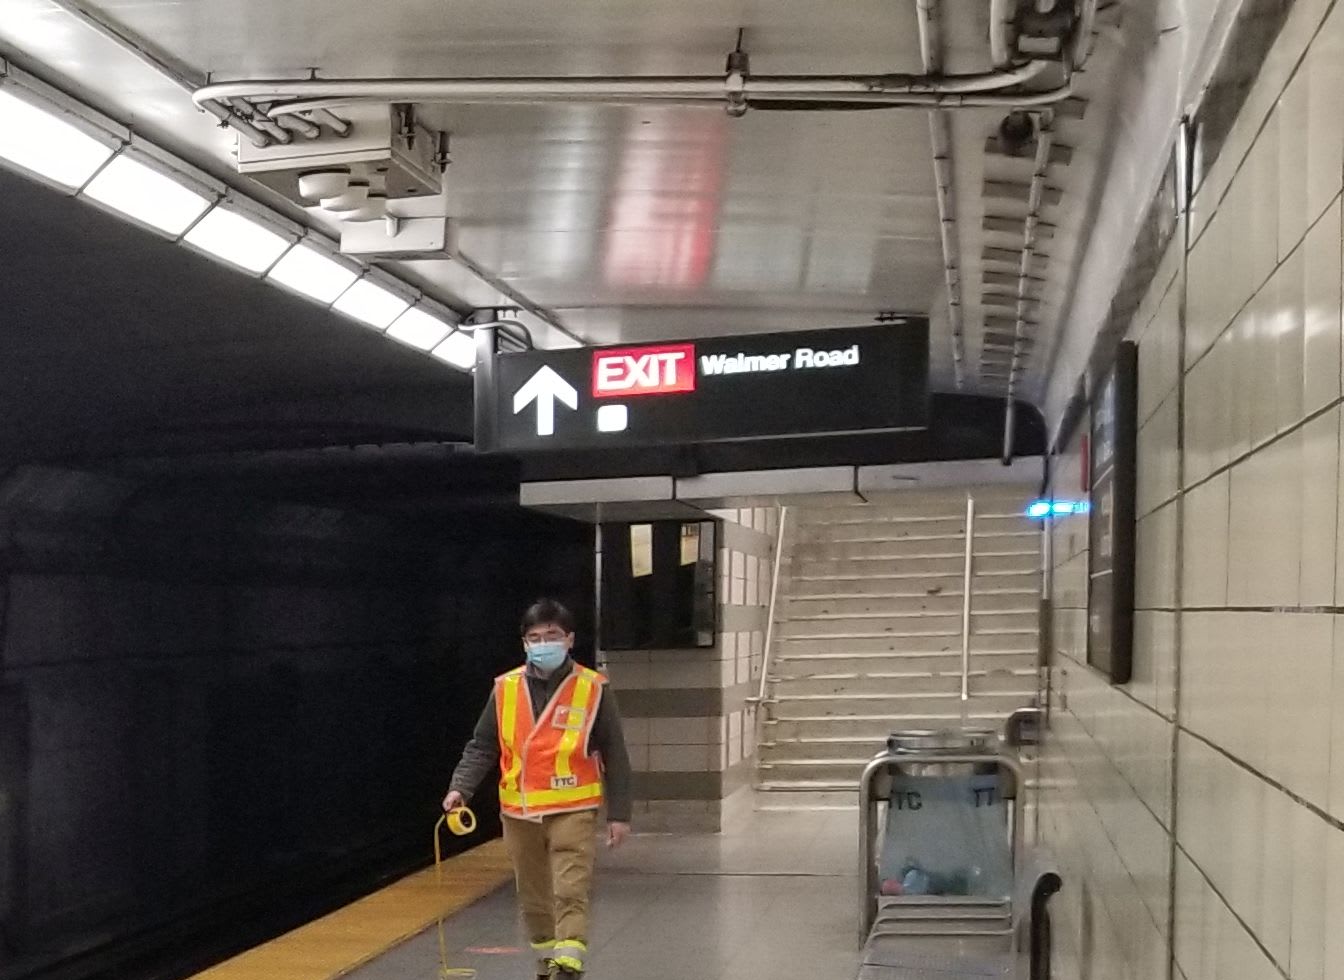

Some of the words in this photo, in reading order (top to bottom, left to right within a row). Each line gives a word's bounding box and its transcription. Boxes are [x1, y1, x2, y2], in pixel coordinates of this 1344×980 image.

[597, 352, 685, 391] EXIT
[700, 353, 791, 376] Walmer
[794, 345, 859, 369] Road
[554, 777, 574, 787] TTC
